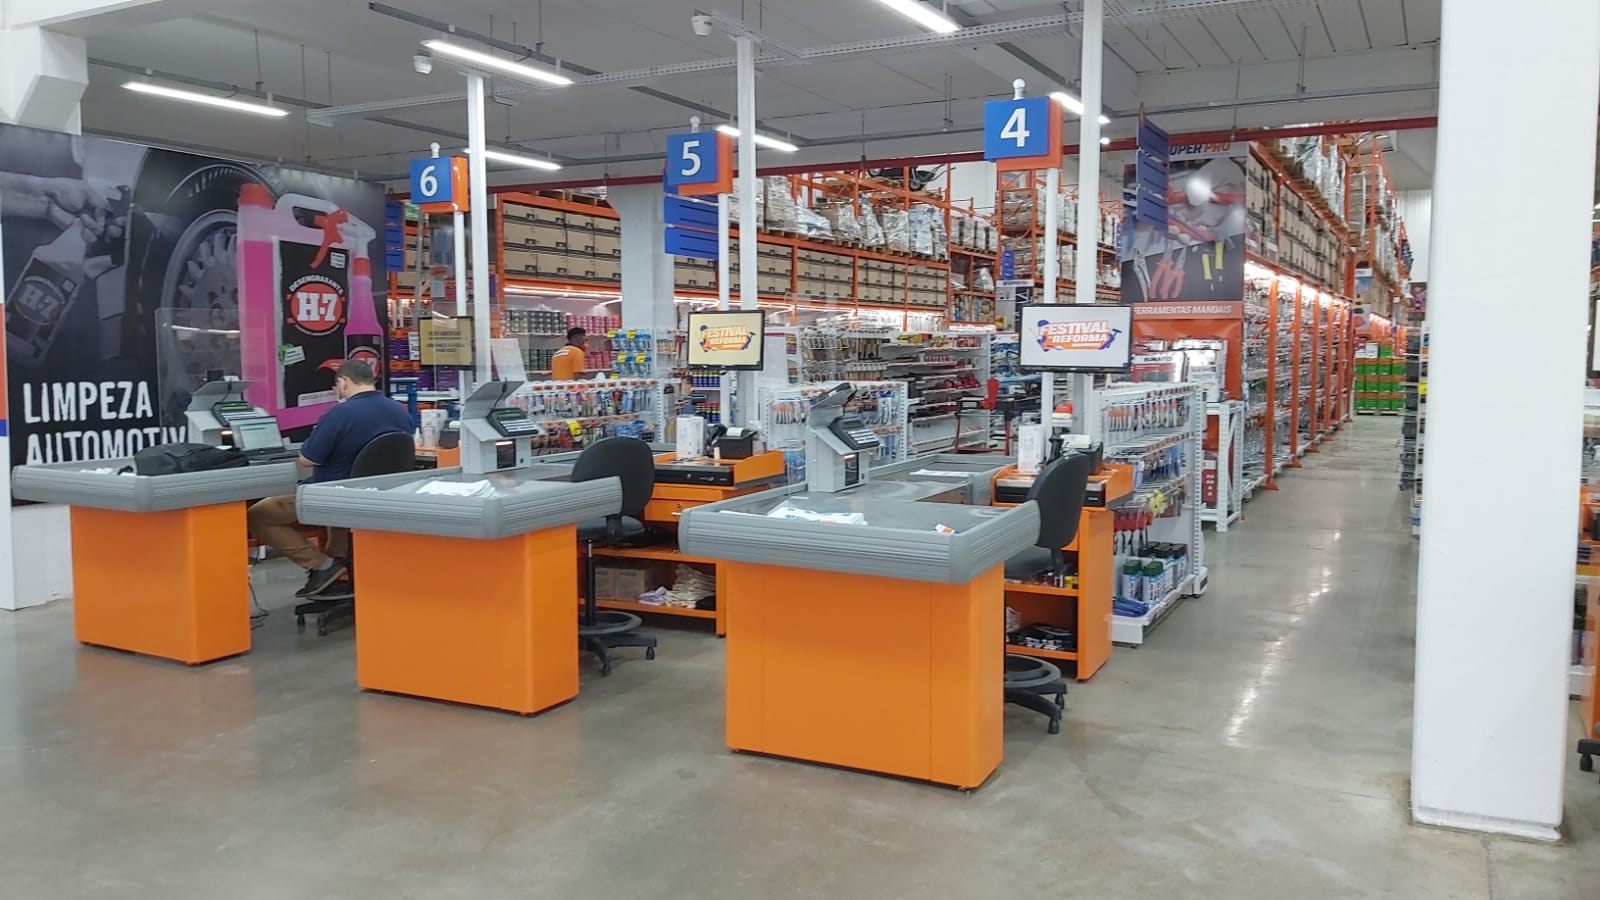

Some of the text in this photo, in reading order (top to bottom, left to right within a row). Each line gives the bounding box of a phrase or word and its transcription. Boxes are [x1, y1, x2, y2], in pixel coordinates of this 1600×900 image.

[1000, 107, 1030, 147] 4
[681, 140, 702, 176] 5
[1168, 142, 1230, 155] UPER PRO
[419, 165, 439, 197] 6
[297, 292, 338, 321] H-7
[1191, 304, 1232, 314] MANUAIS
[702, 325, 748, 337] FESTIVAL
[1040, 321, 1110, 335] FESTIVAL
[1051, 334, 1108, 343] REFORMA
[23, 381, 153, 423] LIMPEZA
[27, 425, 187, 465] AUTOMOTIV
